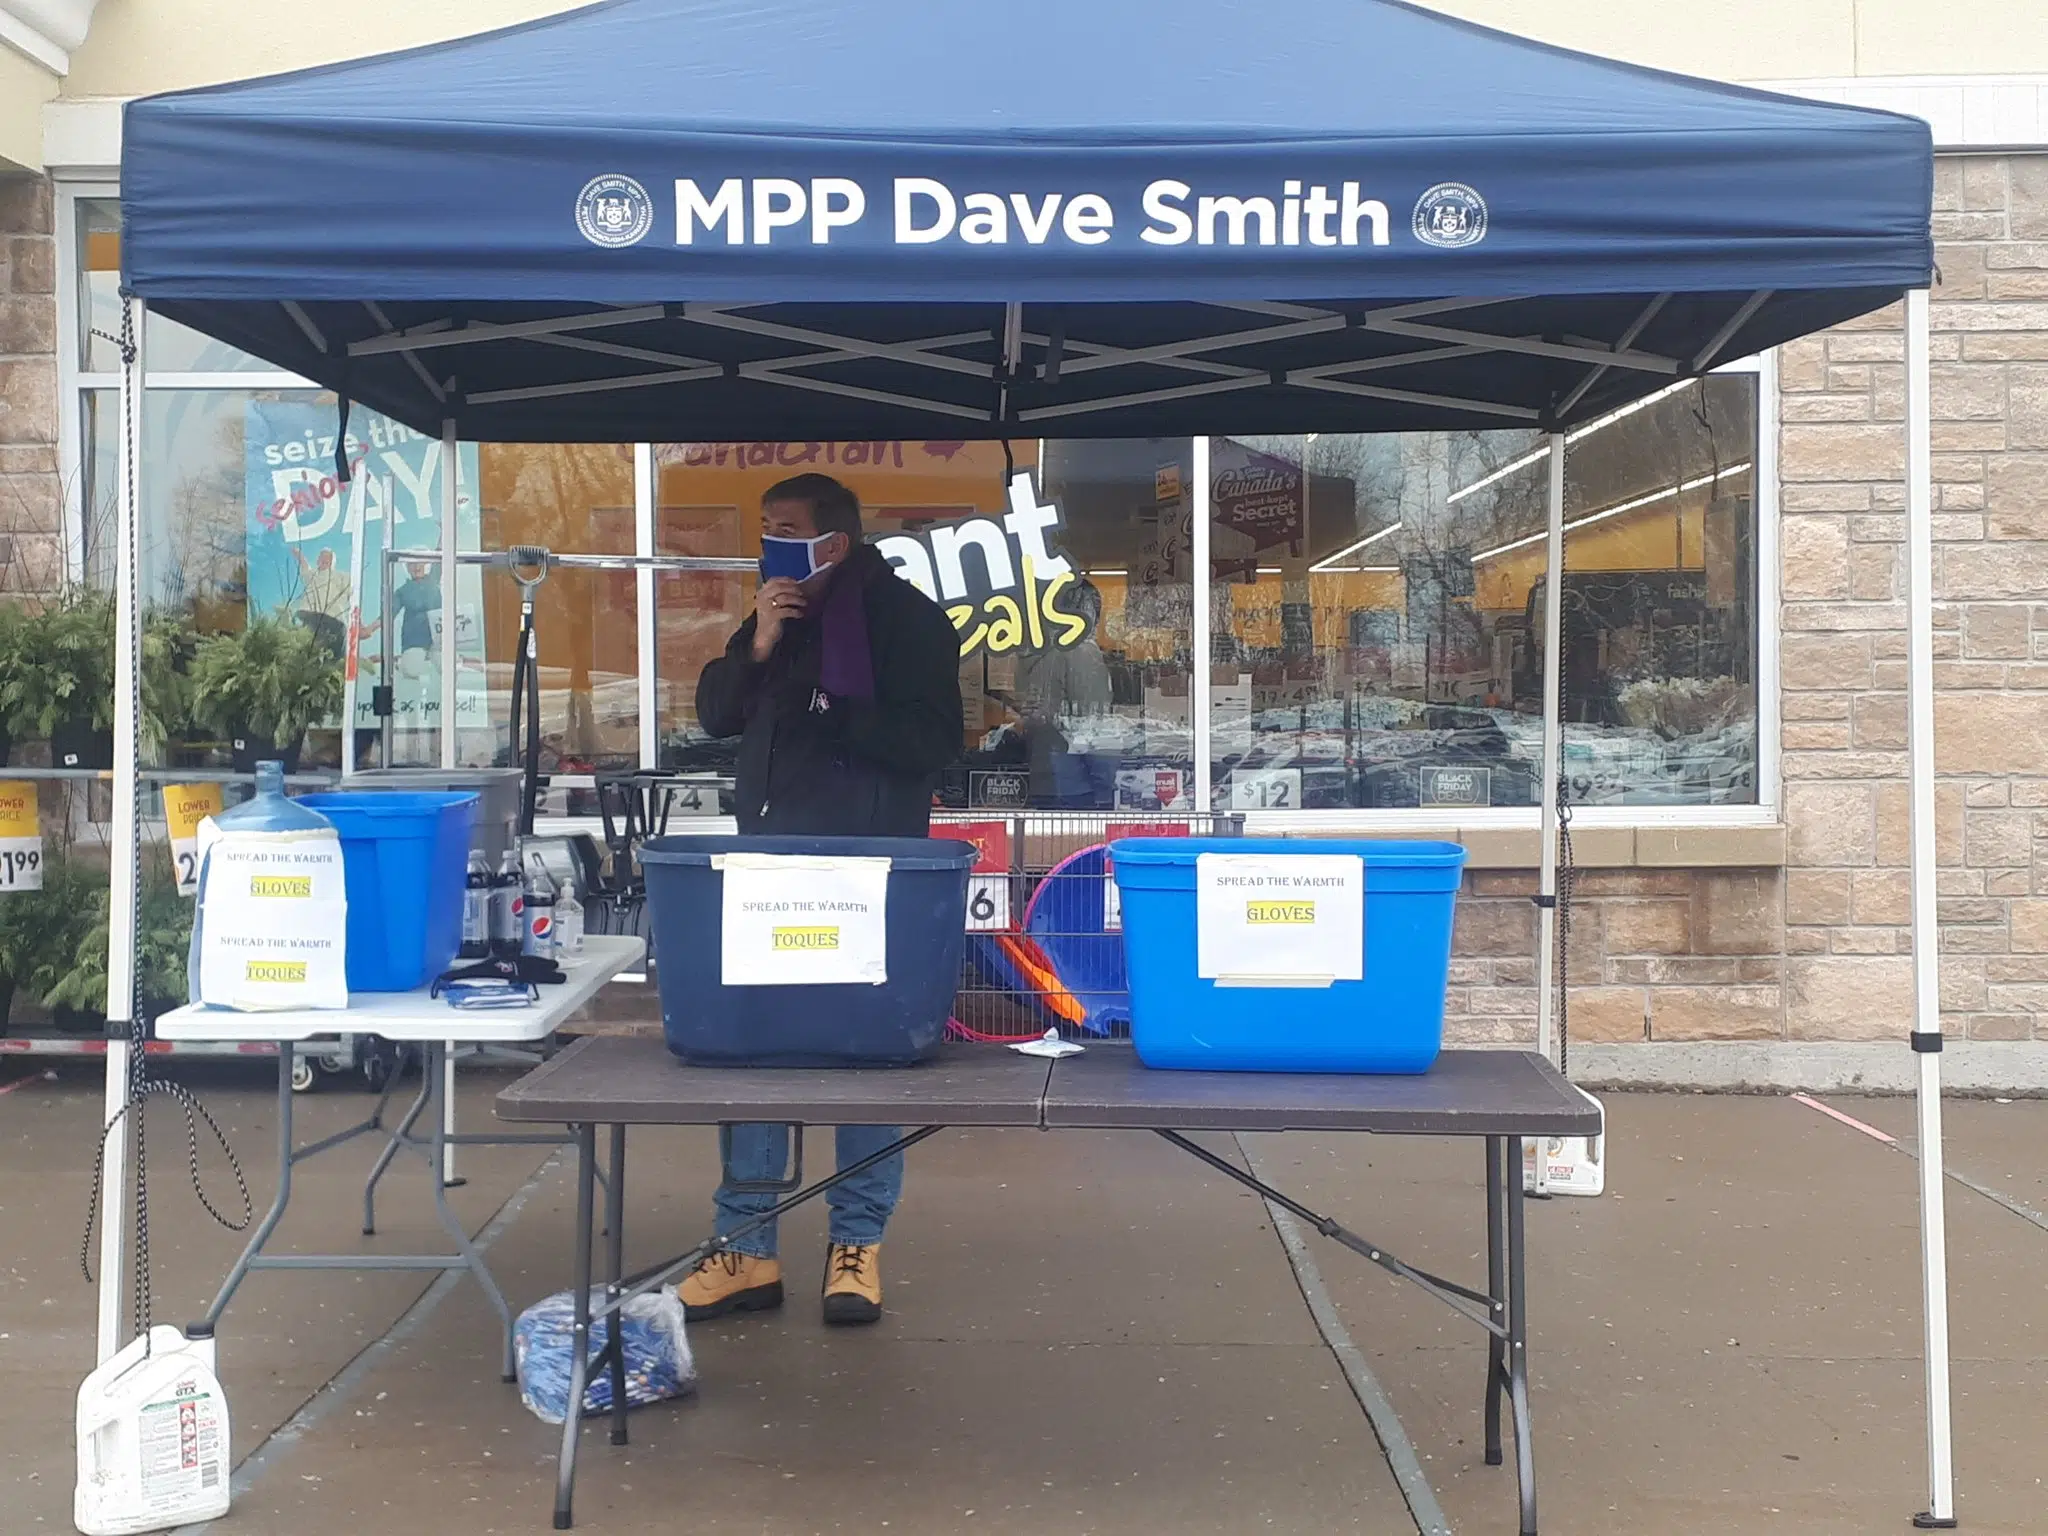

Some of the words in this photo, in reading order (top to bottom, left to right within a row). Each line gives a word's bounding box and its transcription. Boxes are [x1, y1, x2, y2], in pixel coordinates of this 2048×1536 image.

[674, 178, 866, 246] MPP
[894, 177, 1114, 246] Dave
[1138, 178, 1391, 247] Smith
[264, 430, 360, 466] seize
[1211, 469, 1297, 503] Canada's
[1232, 499, 1297, 522] Secret
[874, 472, 1072, 602] ant
[945, 555, 1087, 658] eals
[986, 778, 1021, 788] BLACK
[1437, 773, 1472, 783] BLACK
[986, 786, 1021, 796] FRIDAY
[1244, 780, 1290, 808] $12
[1437, 783, 1474, 792] FRIDAY
[177, 798, 211, 813] LOWER
[226, 852, 268, 863] SPREAD
[271, 852, 292, 863] THE
[294, 852, 333, 864] WARMTH
[250, 879, 311, 896] GLOVES
[1216, 876, 1264, 887] SPREAD
[1266, 876, 1290, 887] THE
[1293, 875, 1345, 887] WARMTH
[742, 901, 790, 912] SPREAD
[792, 901, 815, 911] THE
[817, 900, 868, 913] WARMTH
[969, 887, 995, 921] 6
[1246, 905, 1315, 921] GLOVES
[220, 936, 264, 947] SPREAD
[267, 937, 287, 949] THE
[289, 937, 332, 949] WARMTH
[772, 932, 839, 947] TOQUES
[246, 966, 306, 981] TOQUES
